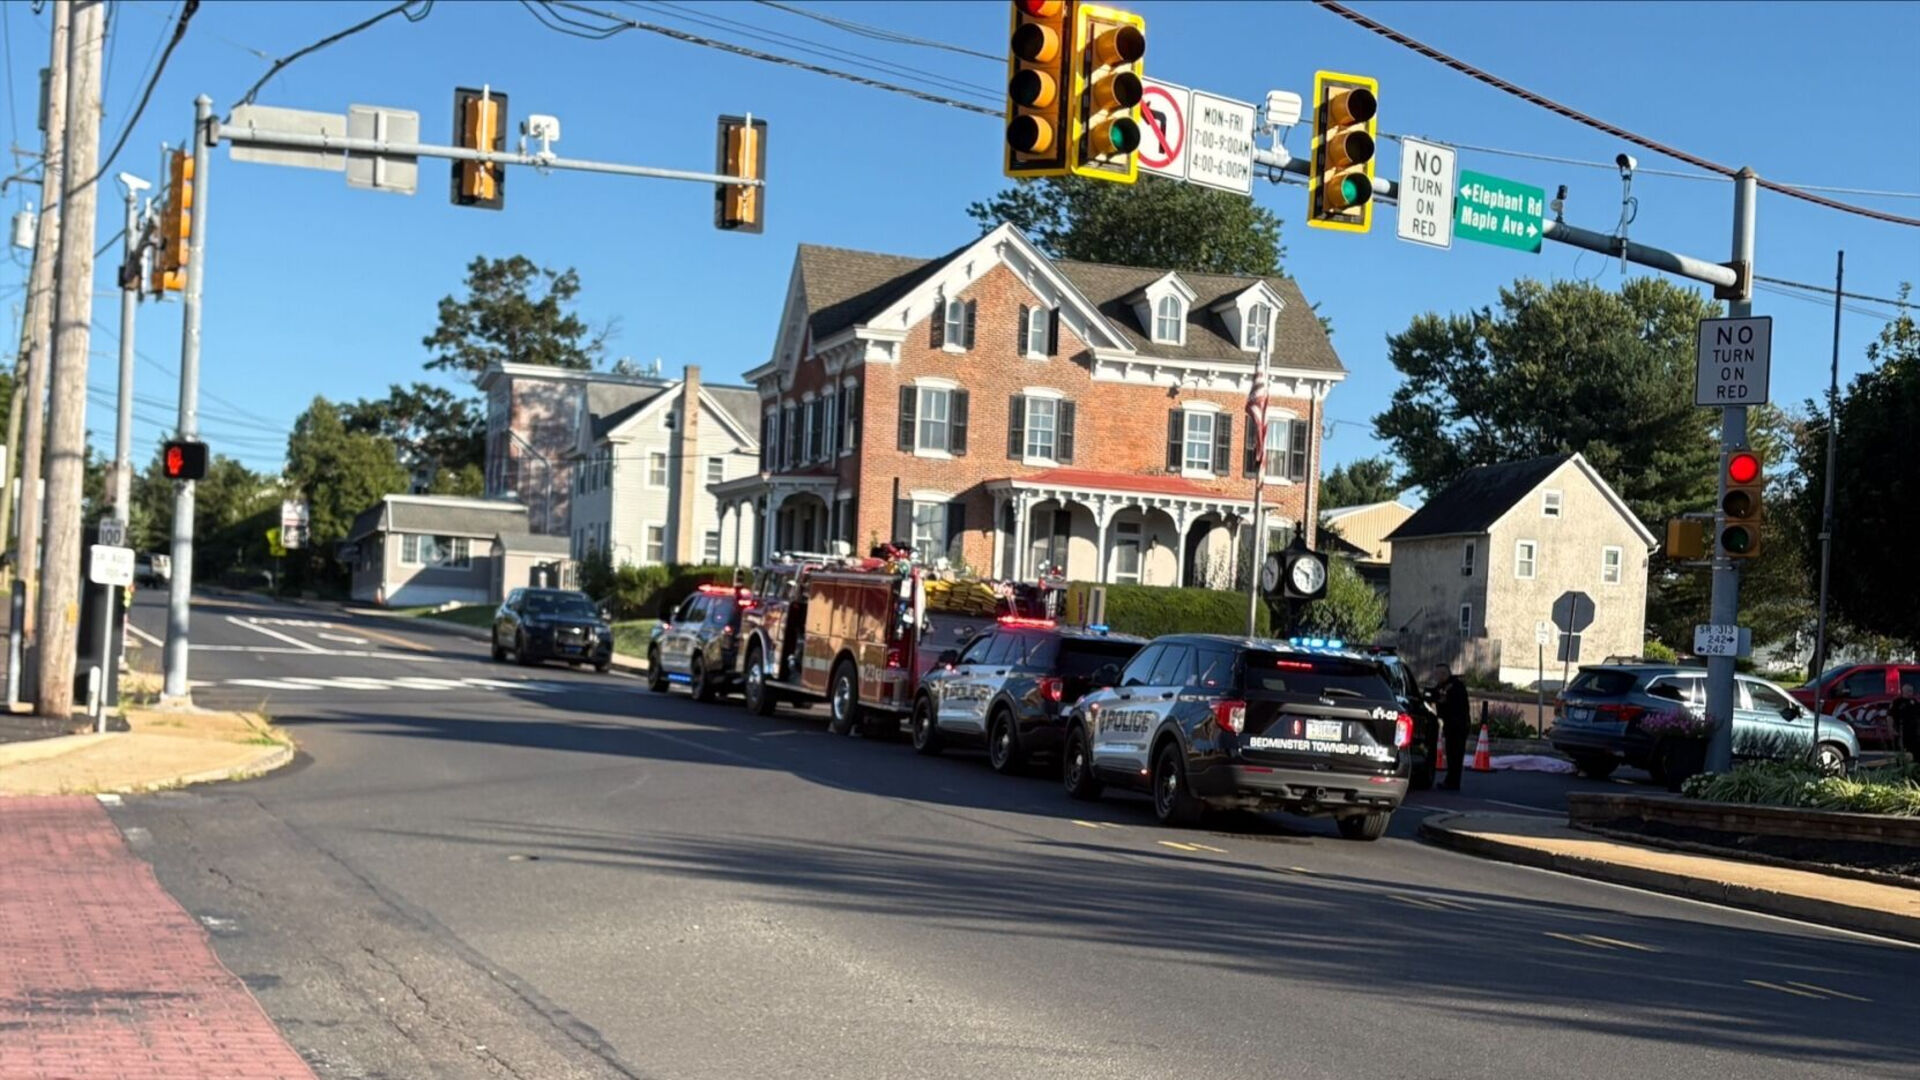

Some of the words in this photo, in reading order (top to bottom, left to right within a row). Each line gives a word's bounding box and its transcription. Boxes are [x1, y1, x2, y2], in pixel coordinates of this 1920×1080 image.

[1203, 107, 1243, 132] MON-FRI
[1194, 129, 1250, 157] 7:00-9:00AM
[1192, 153, 1248, 180] 4:00-6:00PM
[1414, 149, 1442, 176] NO
[1411, 176, 1442, 198] TURN
[1416, 199, 1434, 216] ON
[1472, 183, 1523, 213] Elephant
[1527, 196, 1542, 217] Rd
[1412, 218, 1436, 237] RED
[1461, 205, 1498, 231] Maple
[1502, 214, 1524, 237] Ave
[1717, 326, 1753, 345] NO
[1713, 347, 1754, 363] TURN
[1721, 367, 1744, 381] ON
[1717, 384, 1748, 399] RED
[1106, 709, 1153, 733] POLICE
[1250, 736, 1310, 751] BEDMINSTER
[1312, 740, 1360, 755] TOWNSHIP
[1360, 745, 1389, 757] POLICE
